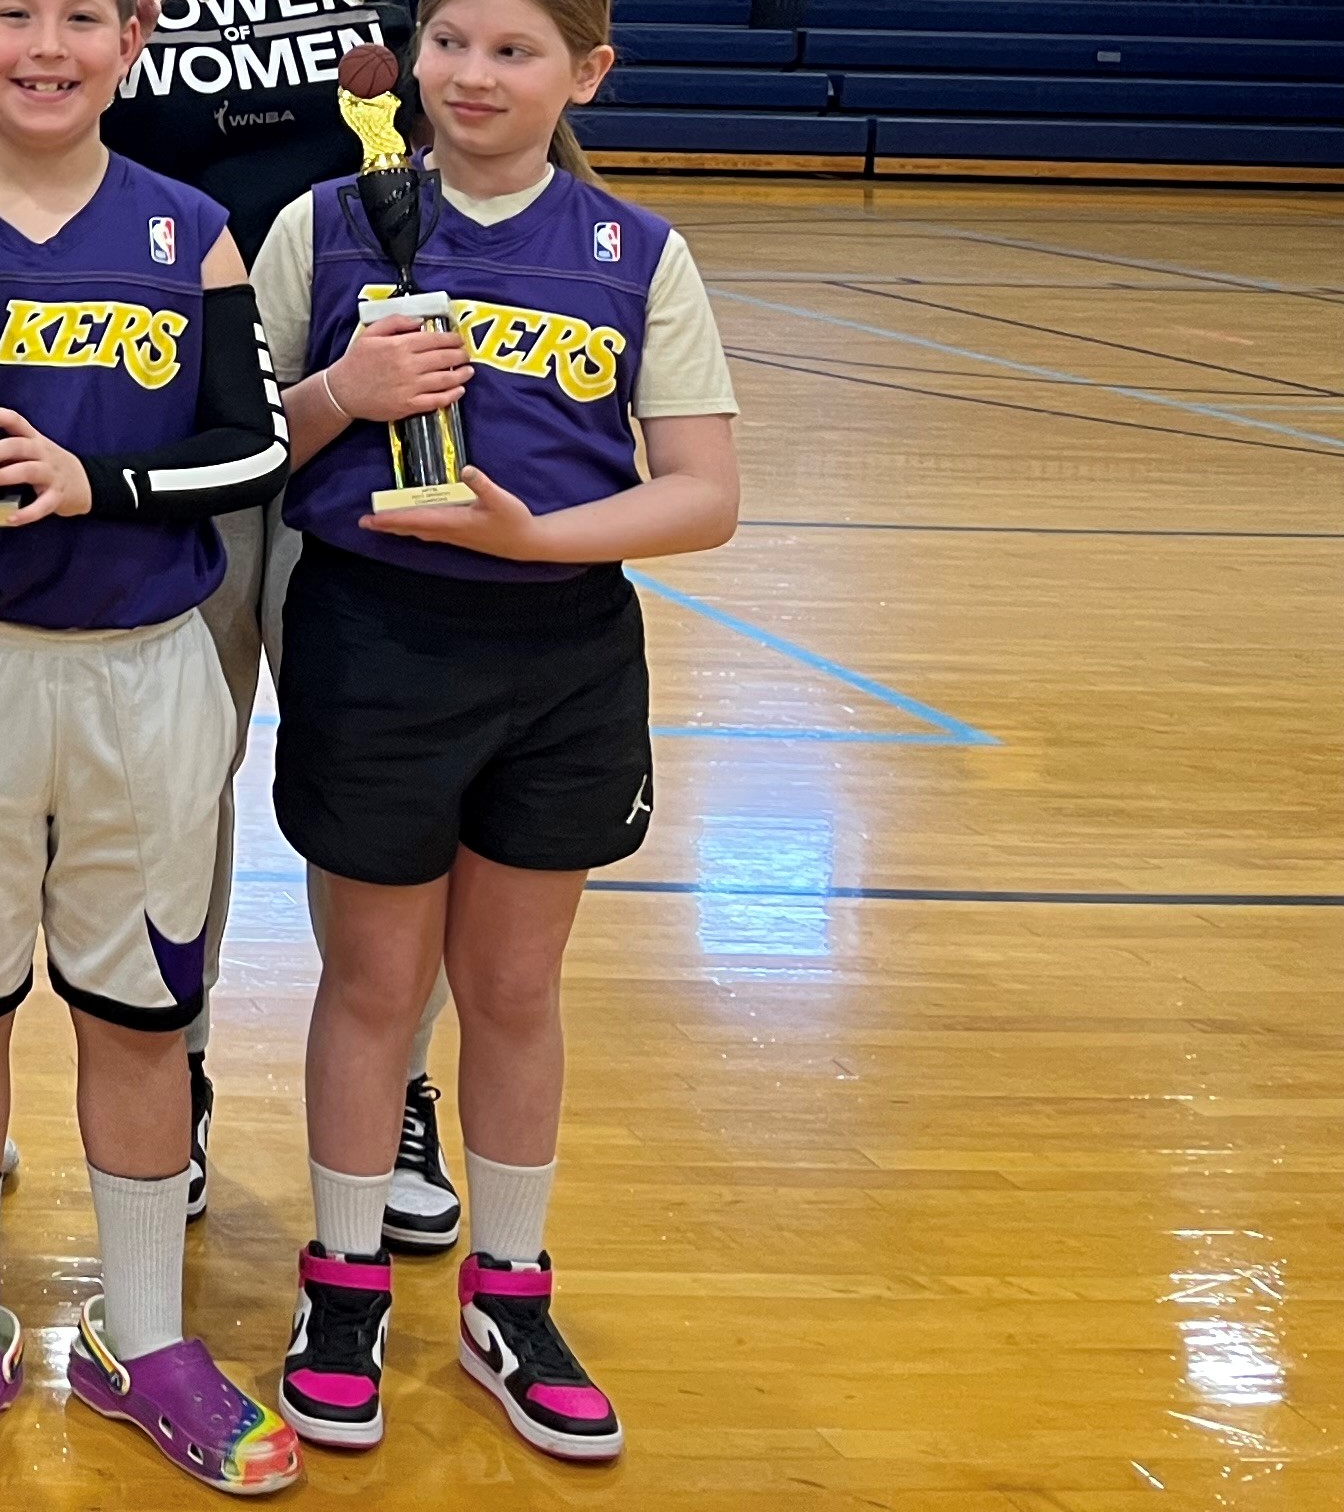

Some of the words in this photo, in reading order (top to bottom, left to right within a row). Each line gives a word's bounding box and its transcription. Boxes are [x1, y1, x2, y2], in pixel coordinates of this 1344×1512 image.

[223, 24, 251, 42] OF
[229, 109, 296, 127] WNBA
[358, 284, 627, 403] KERS
